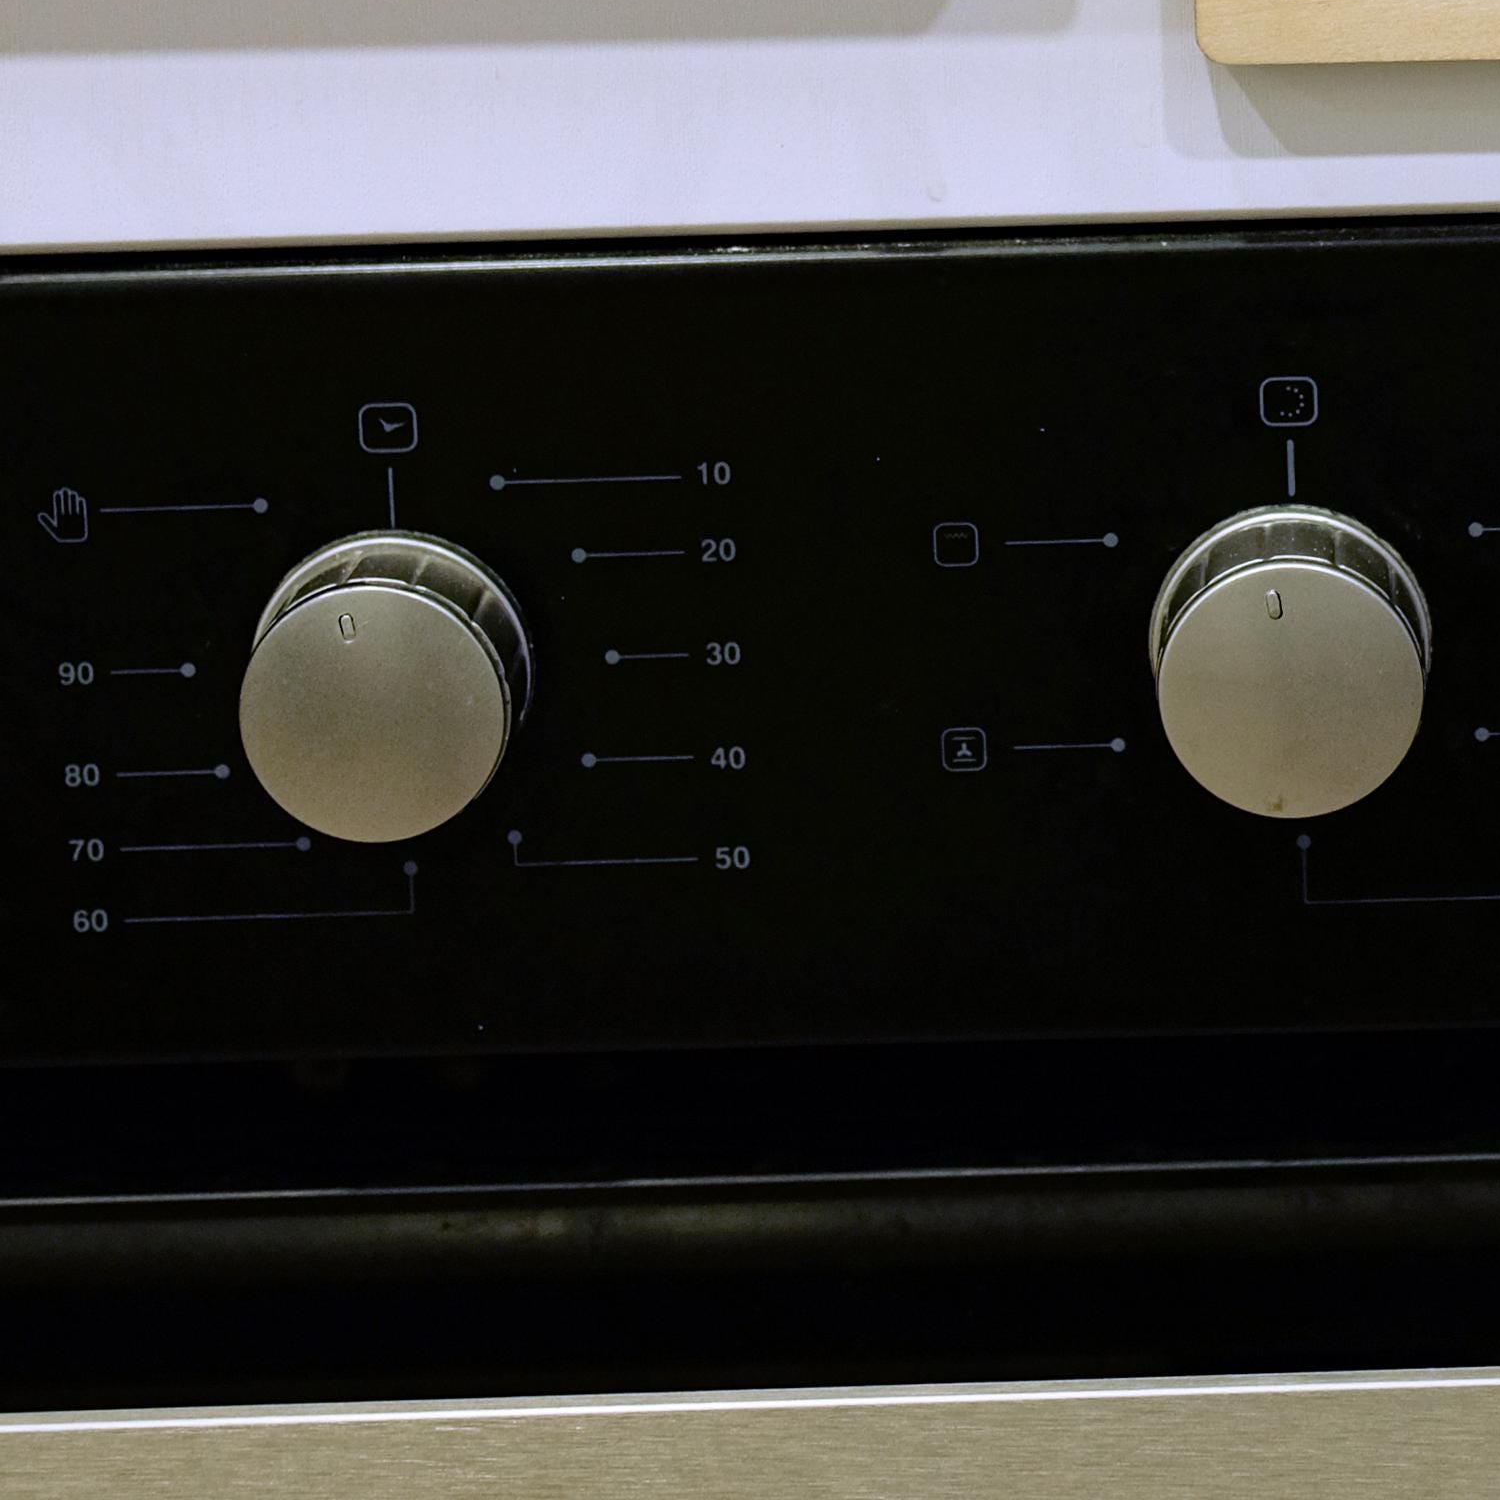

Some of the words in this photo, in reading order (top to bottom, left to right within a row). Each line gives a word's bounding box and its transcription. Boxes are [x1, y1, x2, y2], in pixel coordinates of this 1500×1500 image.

[697, 461, 731, 485] 10
[701, 538, 736, 562] 20
[706, 642, 741, 665] 30
[58, 662, 94, 686] 90
[711, 746, 746, 769] 40
[65, 763, 100, 787] 80
[69, 838, 104, 861] 70
[716, 846, 750, 869] 50
[73, 909, 108, 933] 60
